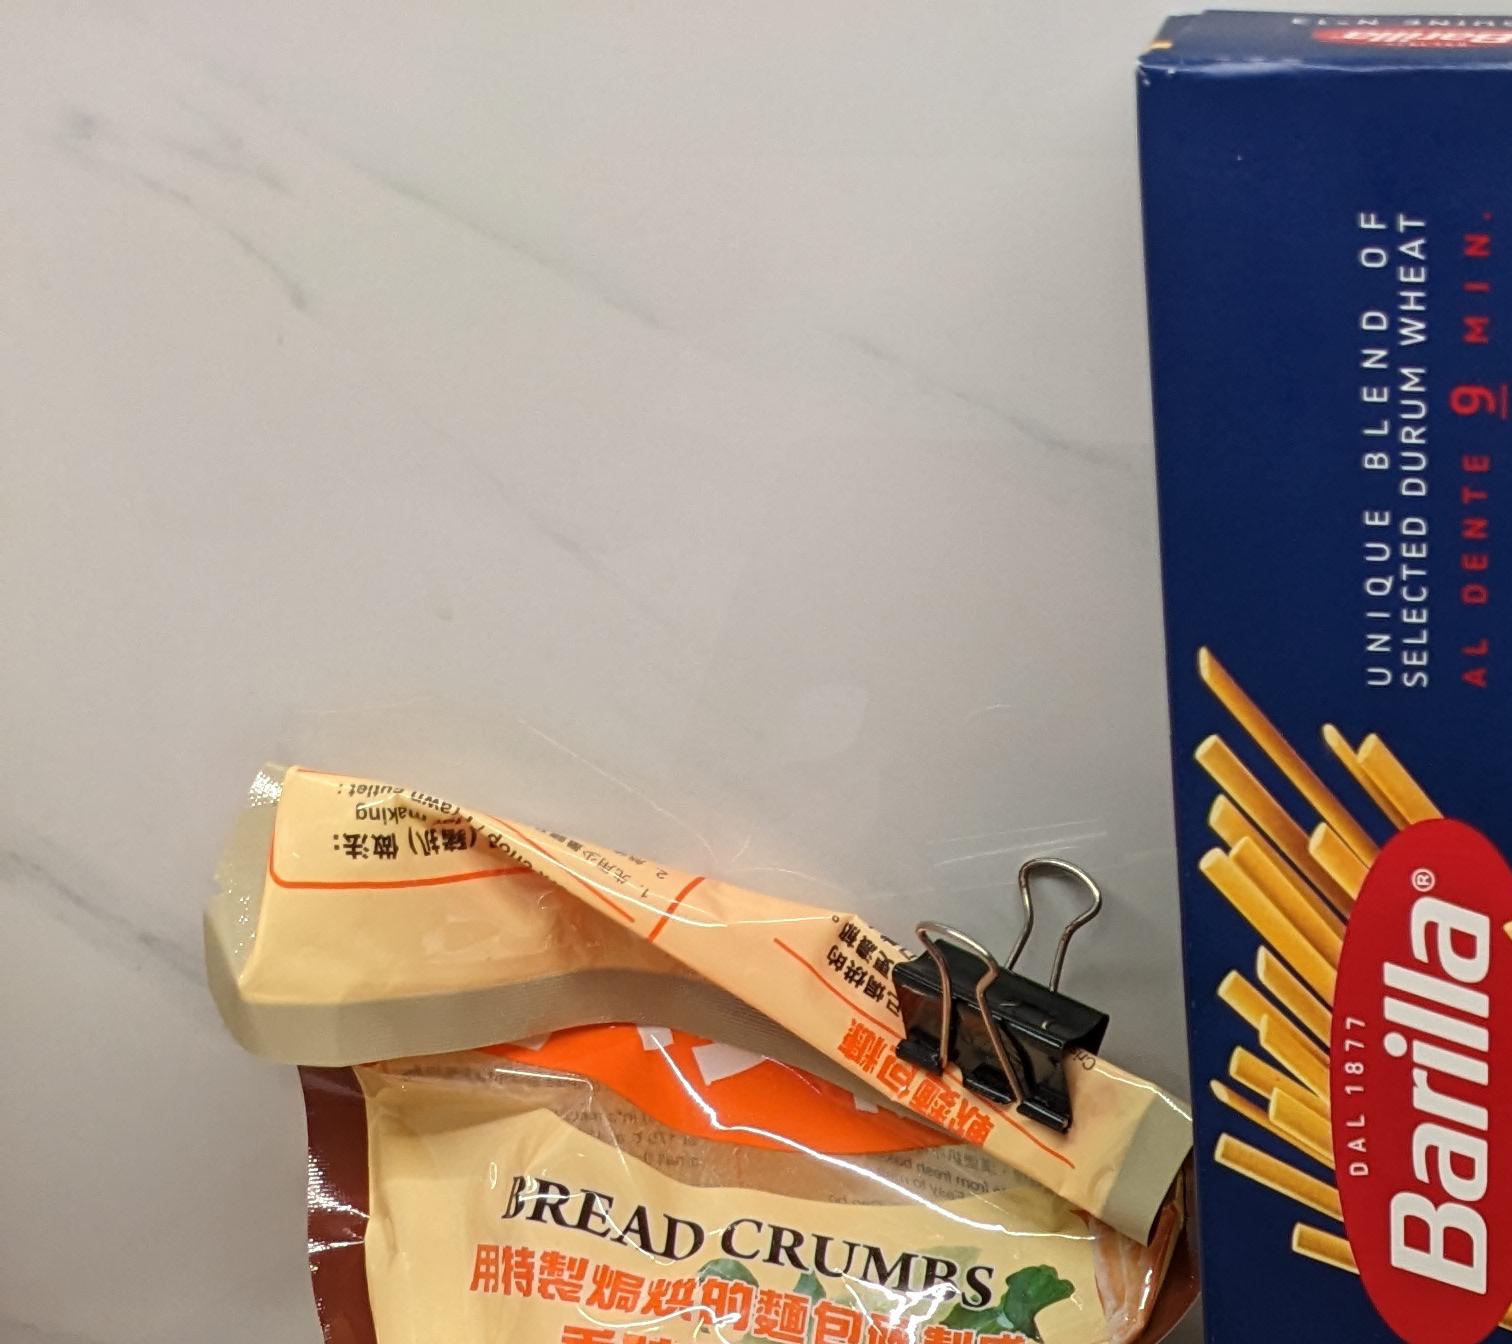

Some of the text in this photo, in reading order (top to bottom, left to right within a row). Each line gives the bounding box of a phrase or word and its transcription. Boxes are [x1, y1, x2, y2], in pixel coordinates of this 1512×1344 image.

[1360, 211, 1393, 687] UNIQUE BLEND OF
[1399, 213, 1428, 688] SELECTED DURUM WHEAT
[1449, 211, 1497, 687] AL DENTE 9 MIN.
[501, 1174, 995, 1310] BREAD CRUMBS
[1344, 1016, 1369, 1178] DAL 1877
[1382, 896, 1492, 1296] Barilla
